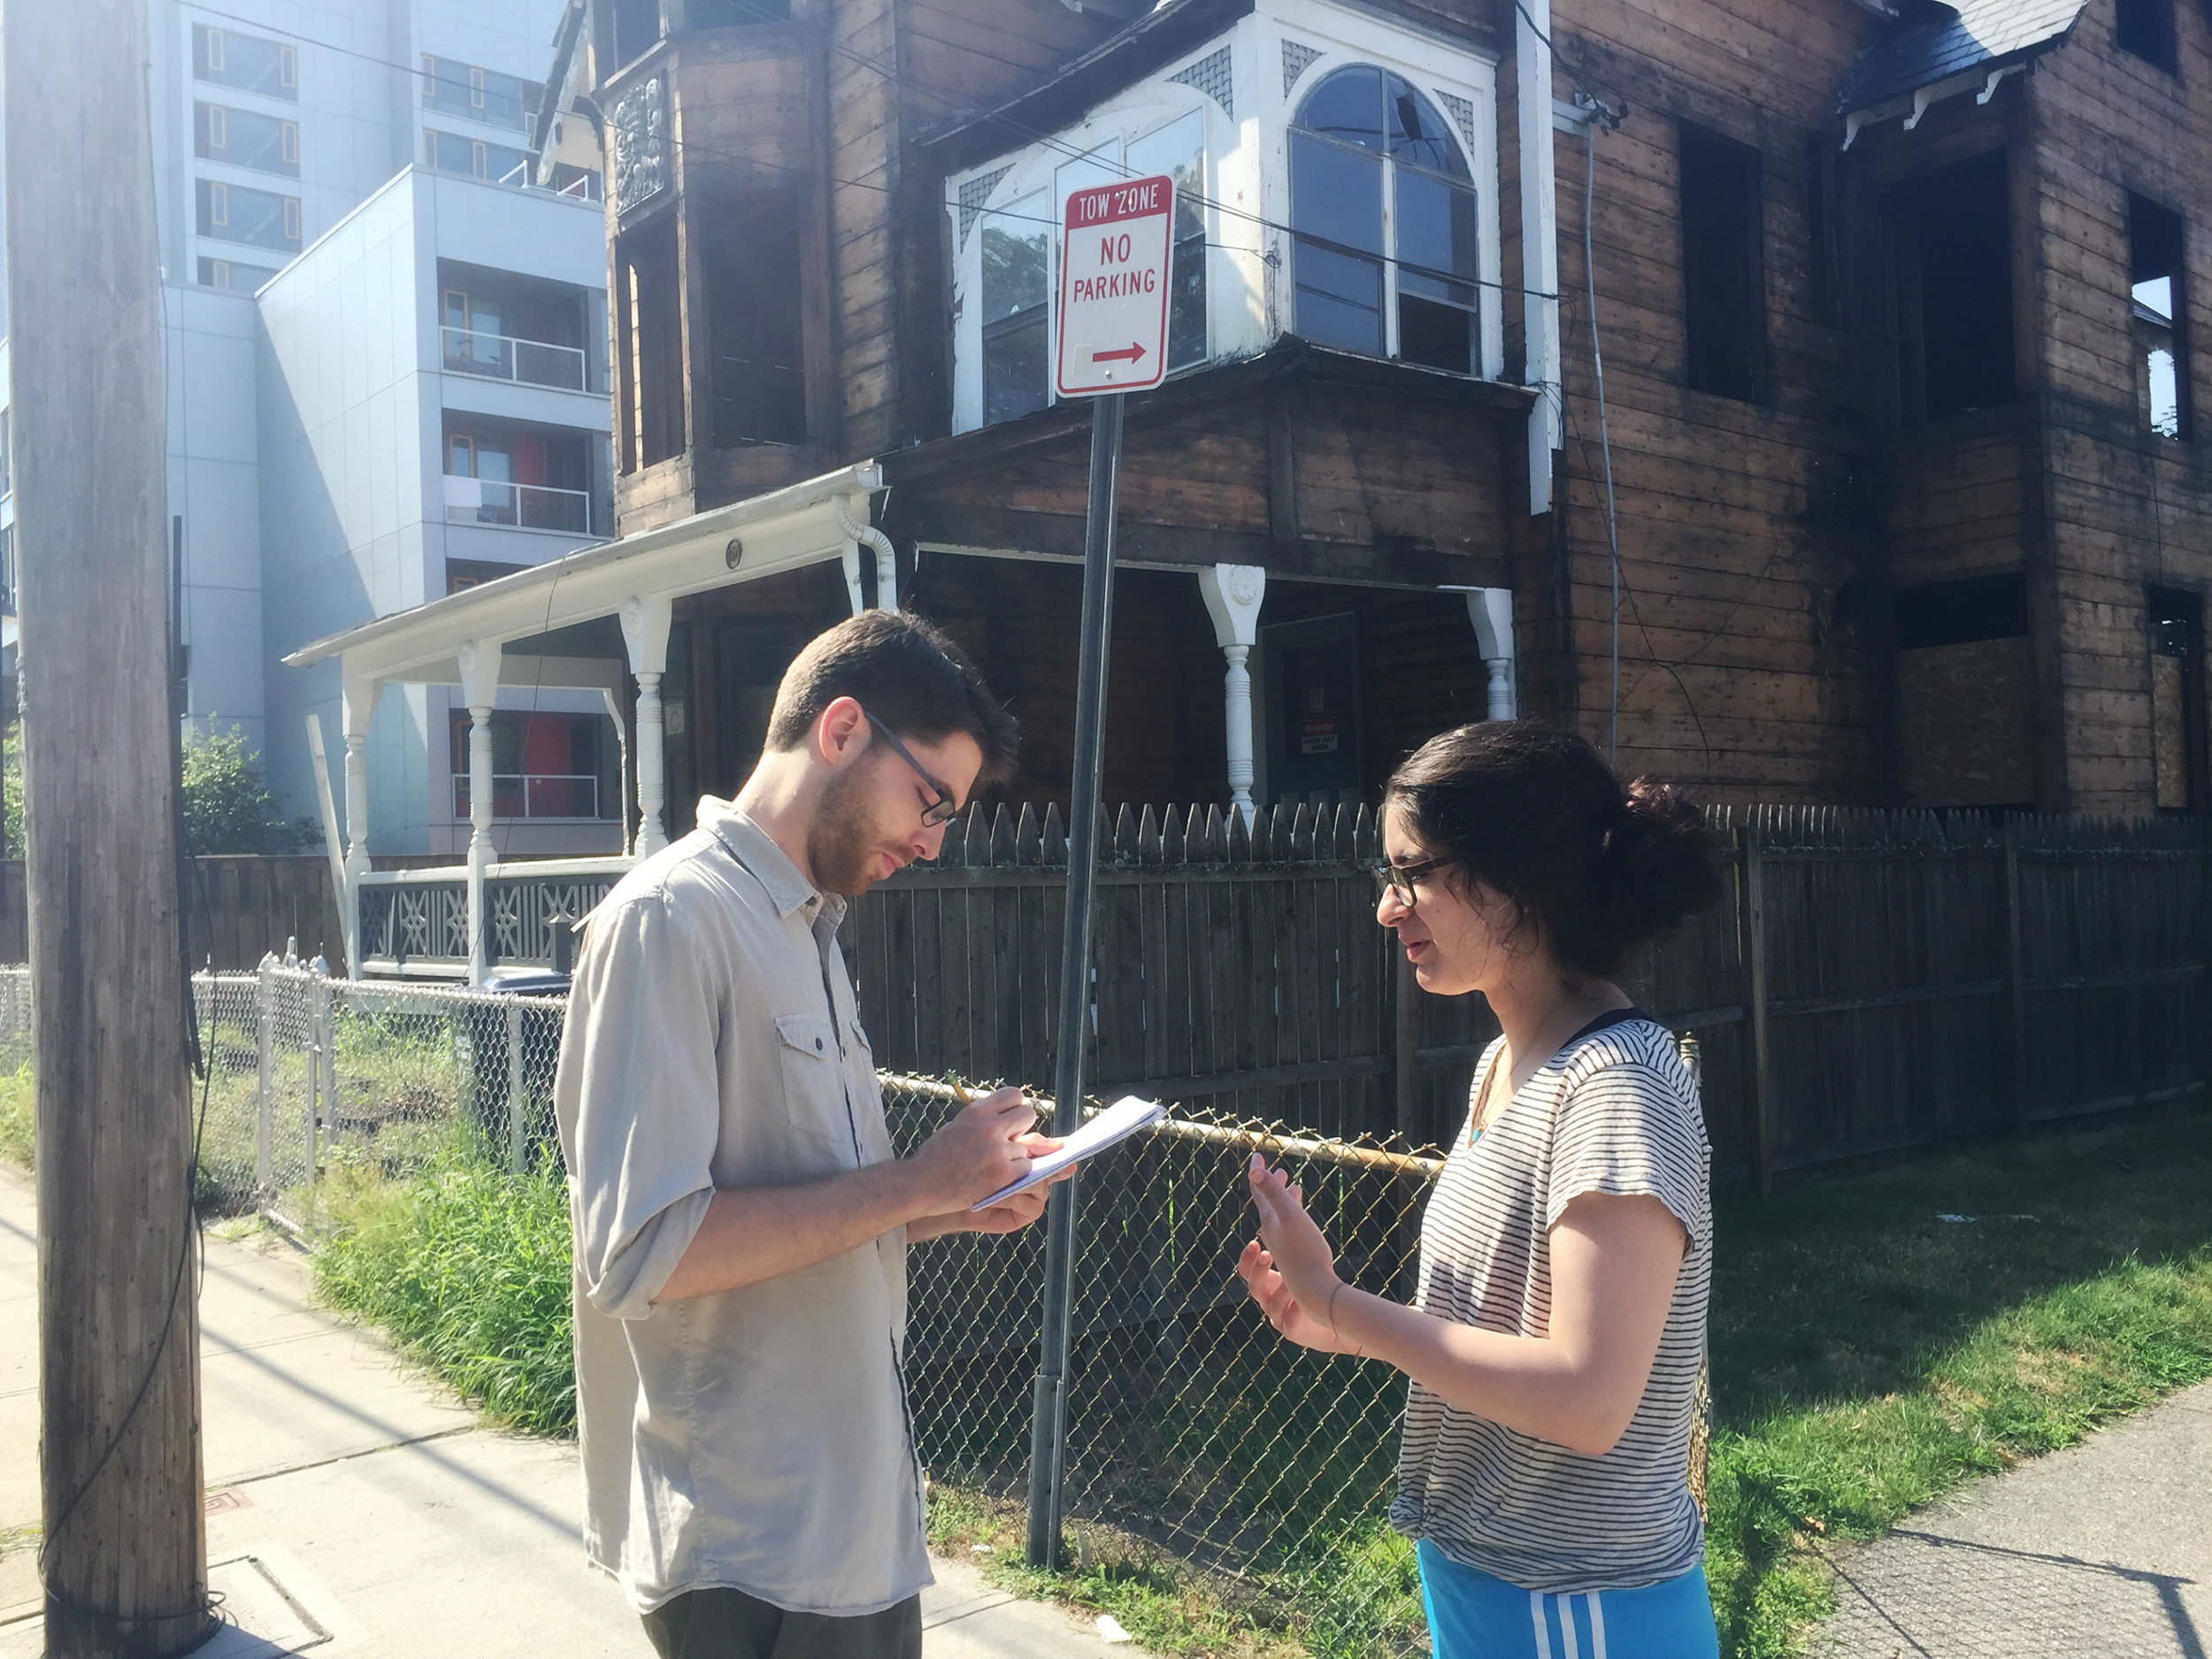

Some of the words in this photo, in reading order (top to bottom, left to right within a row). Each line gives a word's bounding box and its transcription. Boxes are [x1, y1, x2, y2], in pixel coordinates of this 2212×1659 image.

[1079, 193, 1110, 221] TOW
[1118, 183, 1159, 215] ZONE
[1100, 234, 1131, 265] NO
[1073, 268, 1155, 303] PARKING
